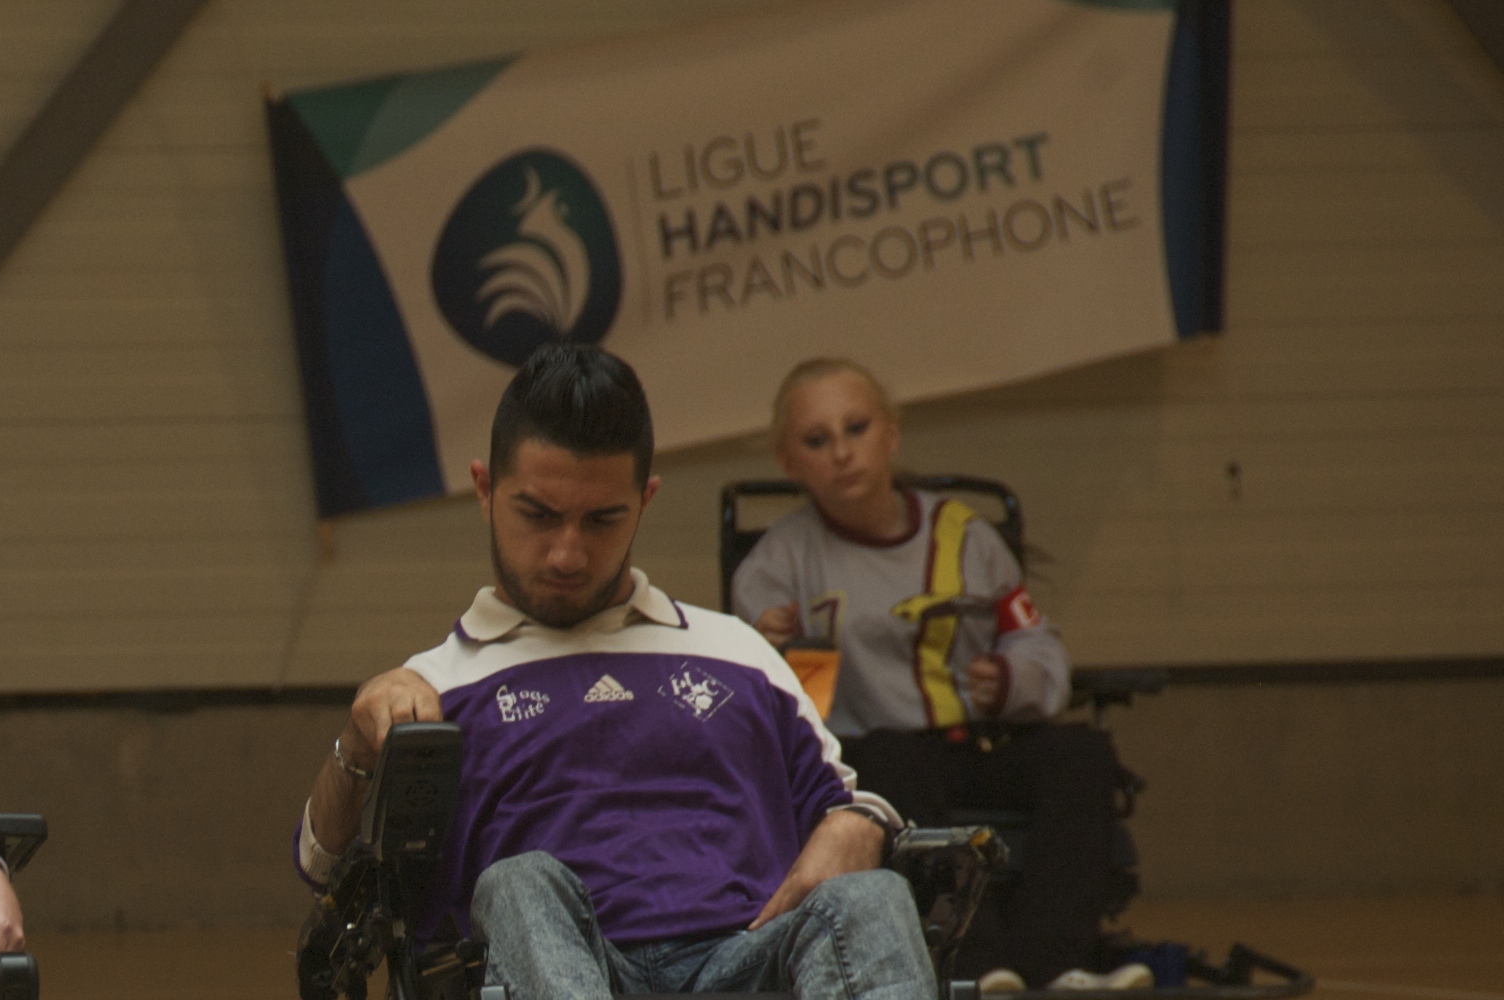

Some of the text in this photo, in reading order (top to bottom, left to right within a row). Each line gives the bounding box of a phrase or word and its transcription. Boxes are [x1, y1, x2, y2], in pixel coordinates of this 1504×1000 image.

[649, 118, 827, 200] LIGUE
[657, 131, 1051, 262] HANDISPORT
[663, 176, 1143, 322] FRANCOPHONE
